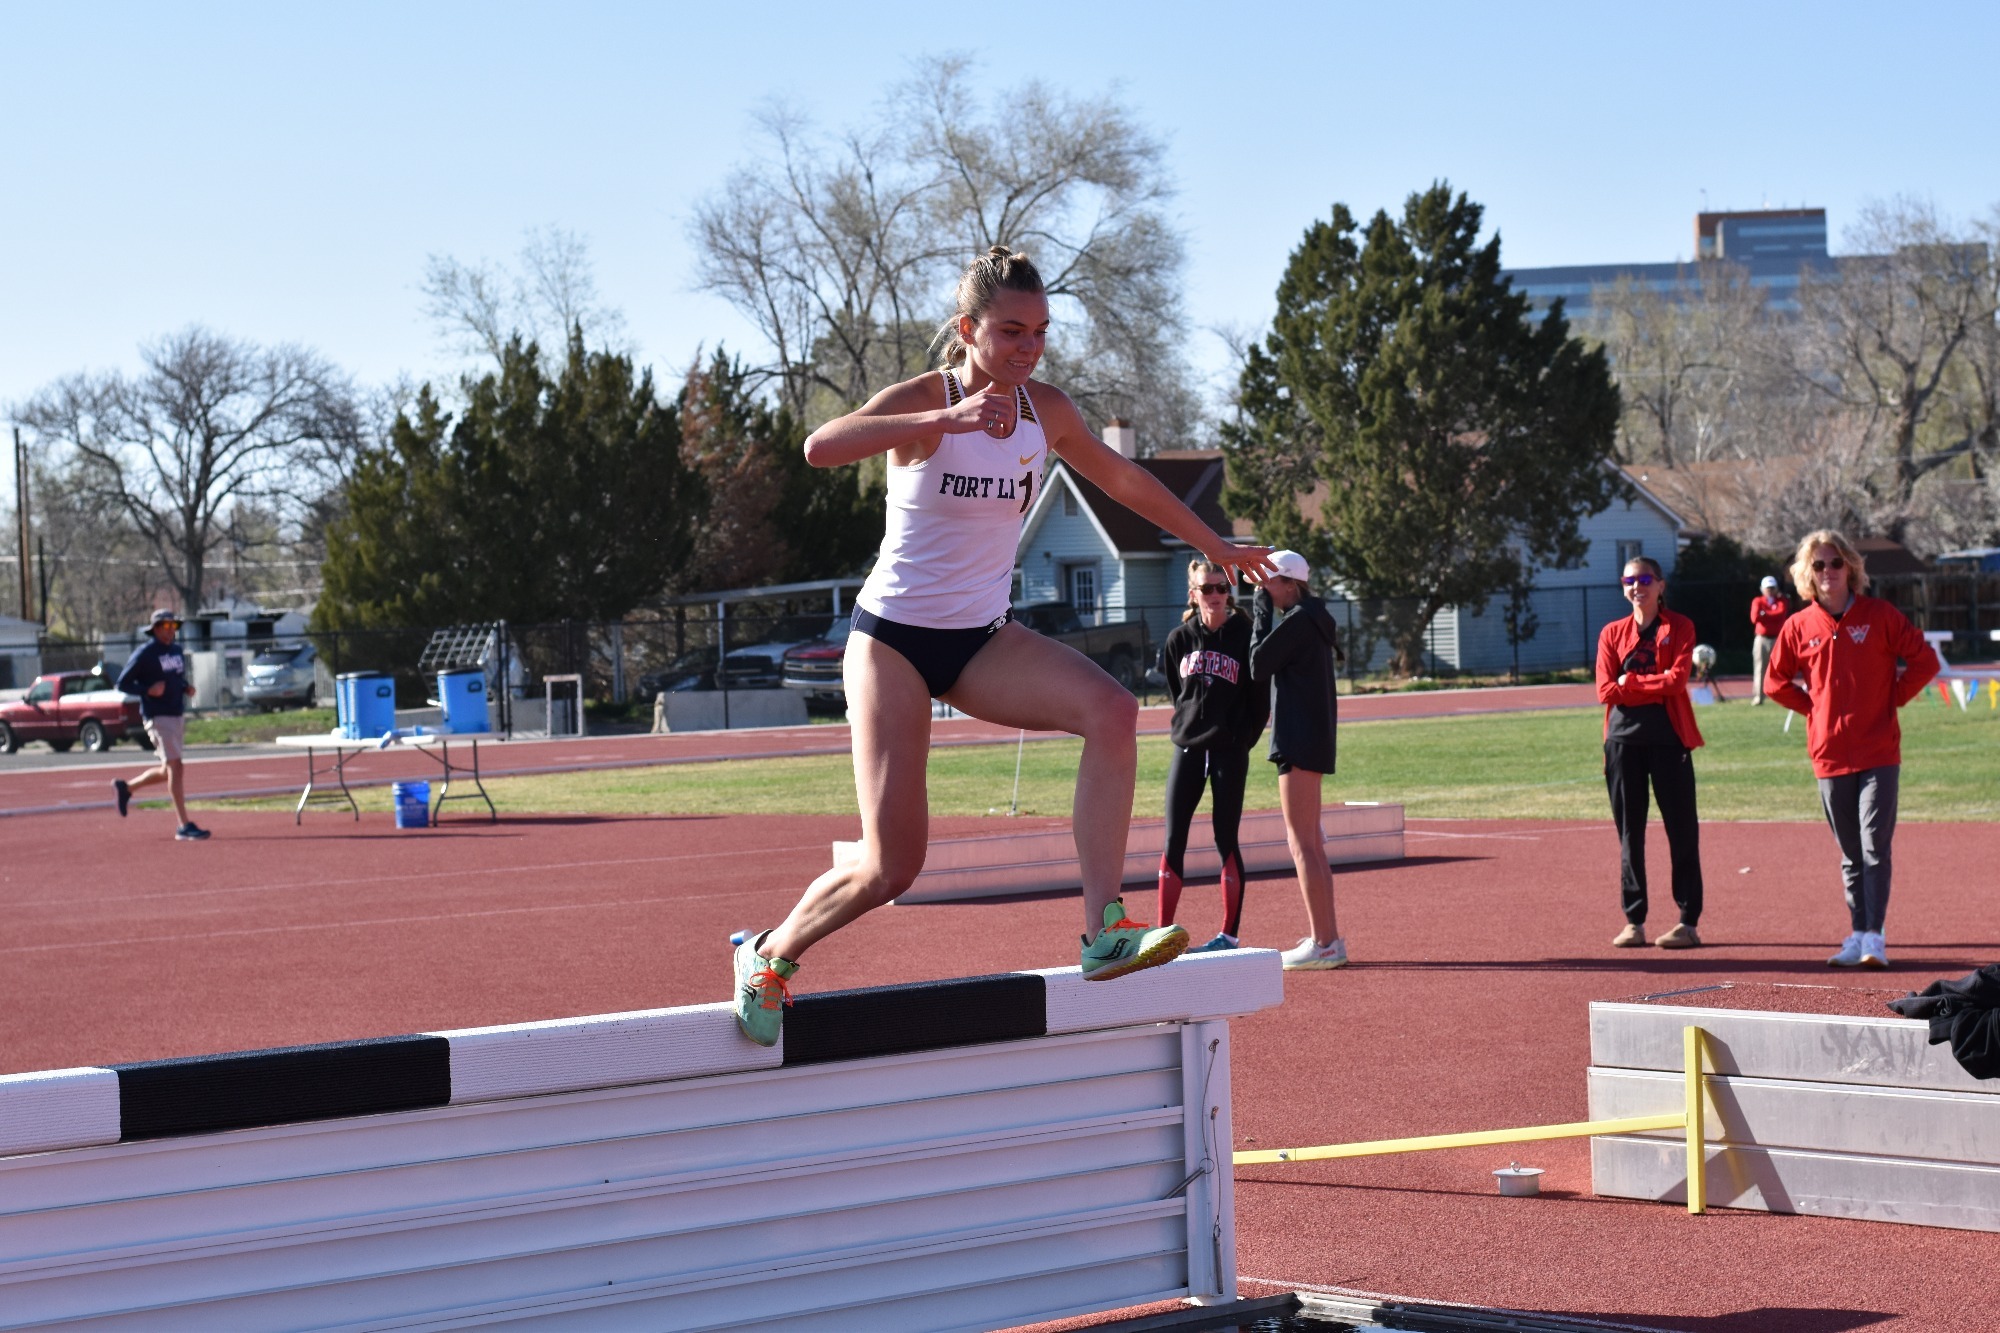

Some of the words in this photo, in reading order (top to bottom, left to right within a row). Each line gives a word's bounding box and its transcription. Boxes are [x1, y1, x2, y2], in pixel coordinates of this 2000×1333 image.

[939, 473, 993, 498] FORT
[1019, 470, 1033, 514] 1
[1179, 650, 1240, 685] WESTERN
